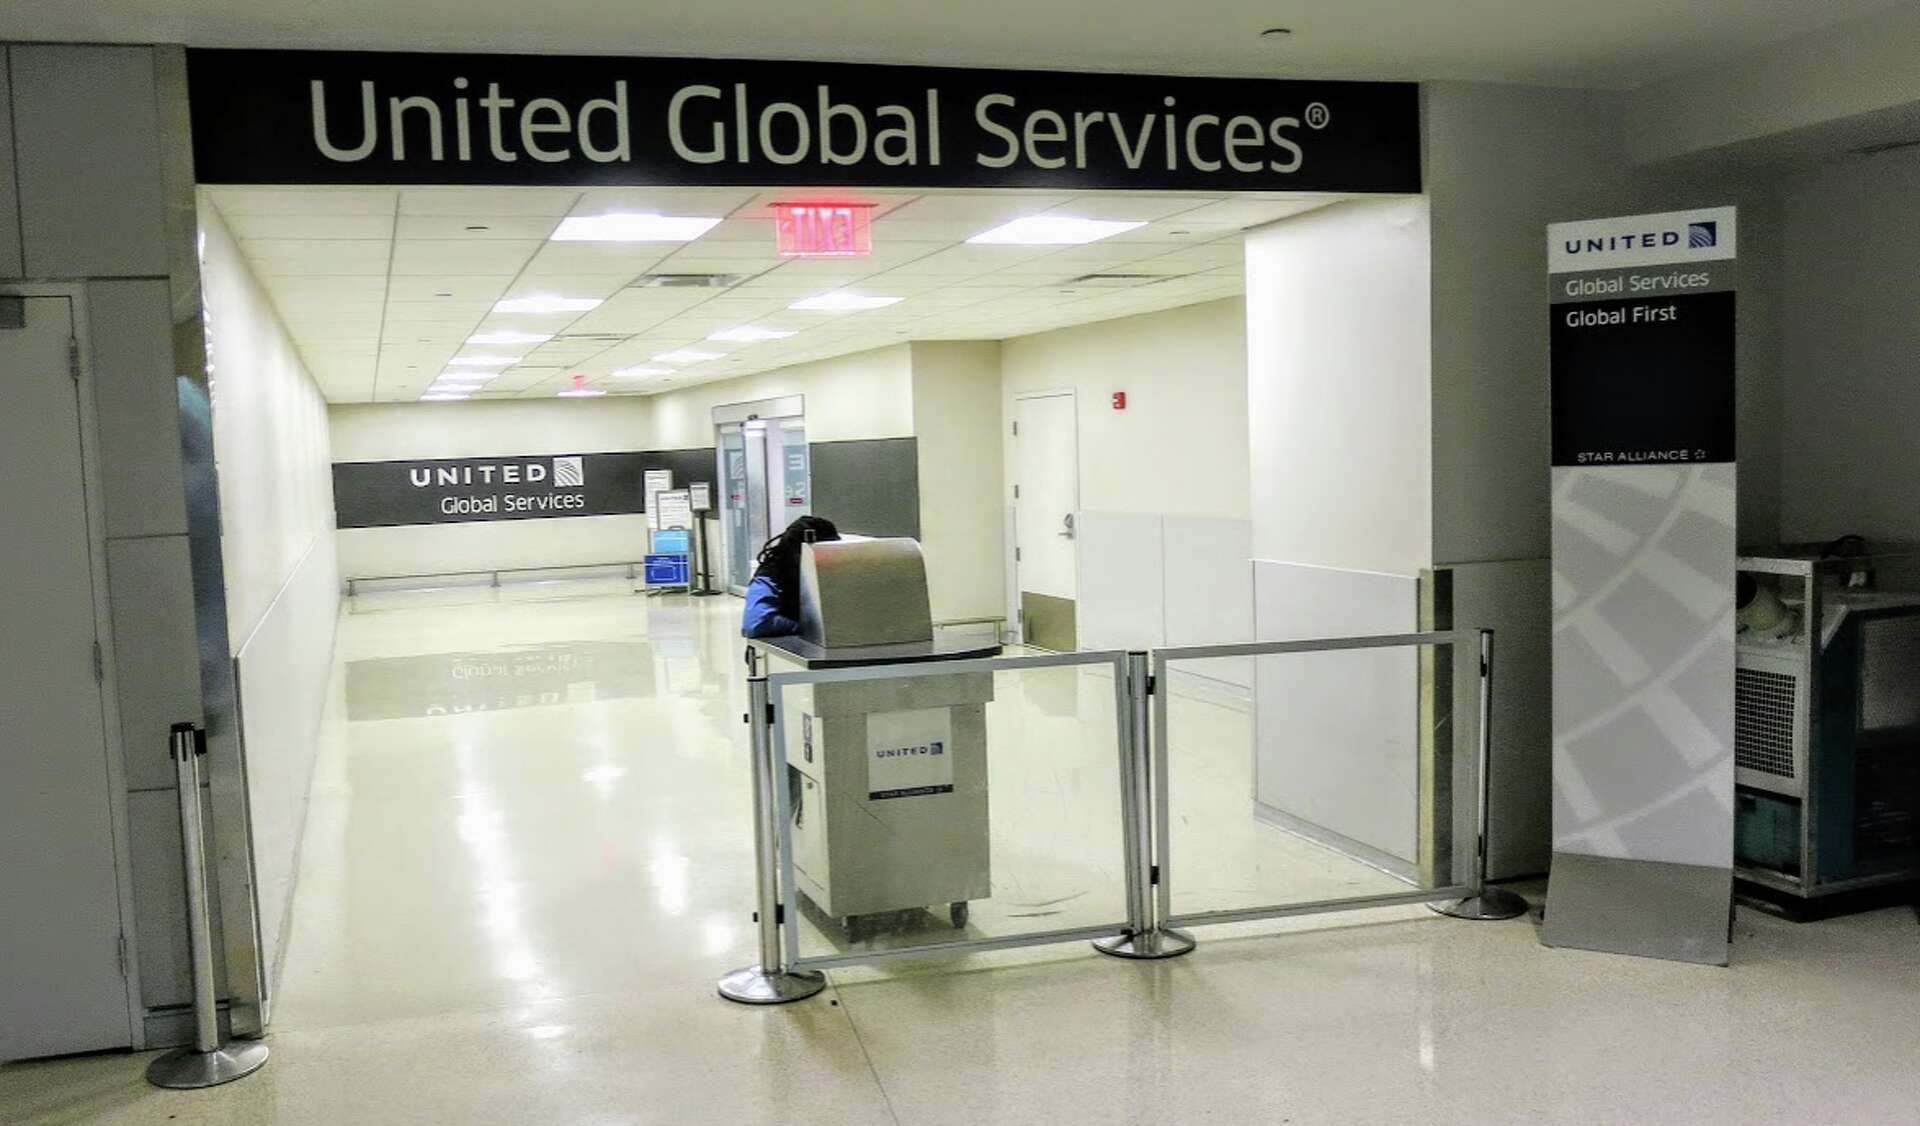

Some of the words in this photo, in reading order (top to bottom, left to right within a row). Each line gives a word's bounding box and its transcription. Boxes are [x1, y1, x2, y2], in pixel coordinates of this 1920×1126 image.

[311, 77, 631, 163] United
[667, 82, 941, 166] Global
[1565, 231, 1680, 255] UNITED
[1565, 275, 1624, 297] Global
[1629, 271, 1710, 292] Services
[1565, 307, 1626, 328] Global
[1632, 305, 1678, 323] First
[1577, 451, 1614, 463] STAR
[1617, 449, 1689, 461] ALLIANCE
[410, 464, 547, 488] UNITED
[440, 495, 498, 514] Global
[504, 492, 585, 512] Services
[876, 746, 928, 758] UNITED
